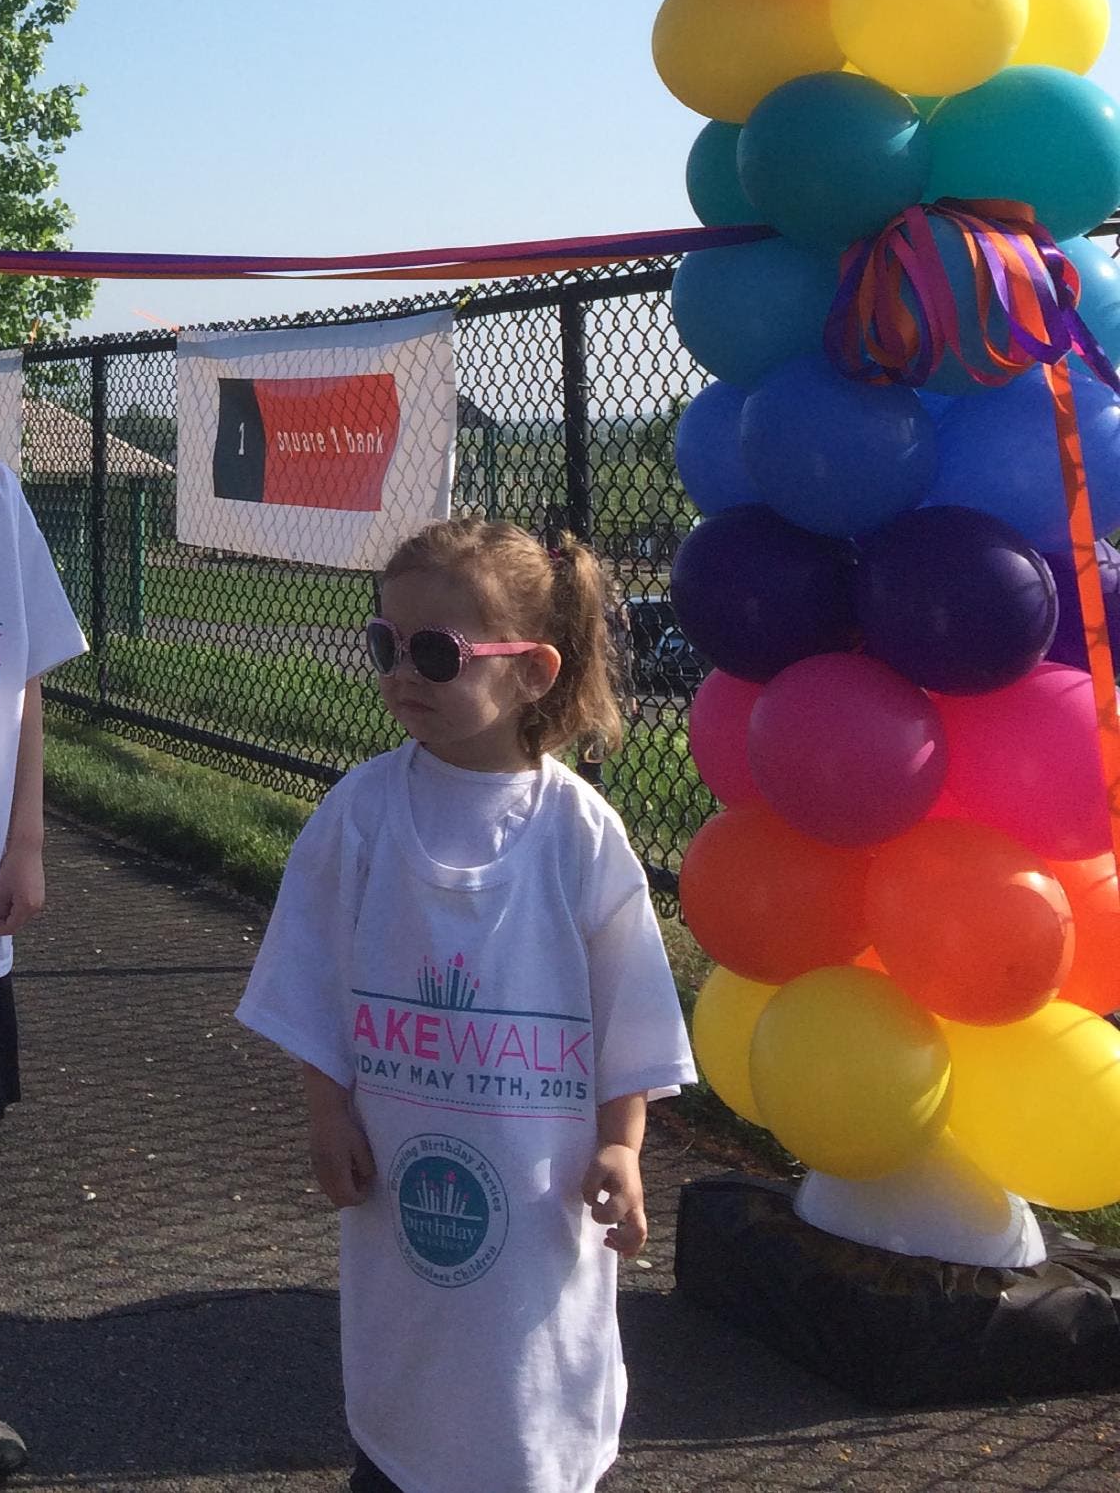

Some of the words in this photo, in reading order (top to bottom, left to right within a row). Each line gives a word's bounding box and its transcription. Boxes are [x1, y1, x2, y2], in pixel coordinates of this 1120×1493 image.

[238, 421, 246, 456] 1
[277, 431, 326, 458] square
[330, 426, 340, 454] 1
[343, 425, 384, 454] bank
[353, 1003, 592, 1076] AKEWALK
[410, 1064, 455, 1091] MAY
[466, 1073, 530, 1100] 17TH,
[540, 1078, 588, 1100] 2015
[420, 1139, 474, 1165] Birthday
[476, 1161, 502, 1213] Parties
[453, 1245, 498, 1282] Children
